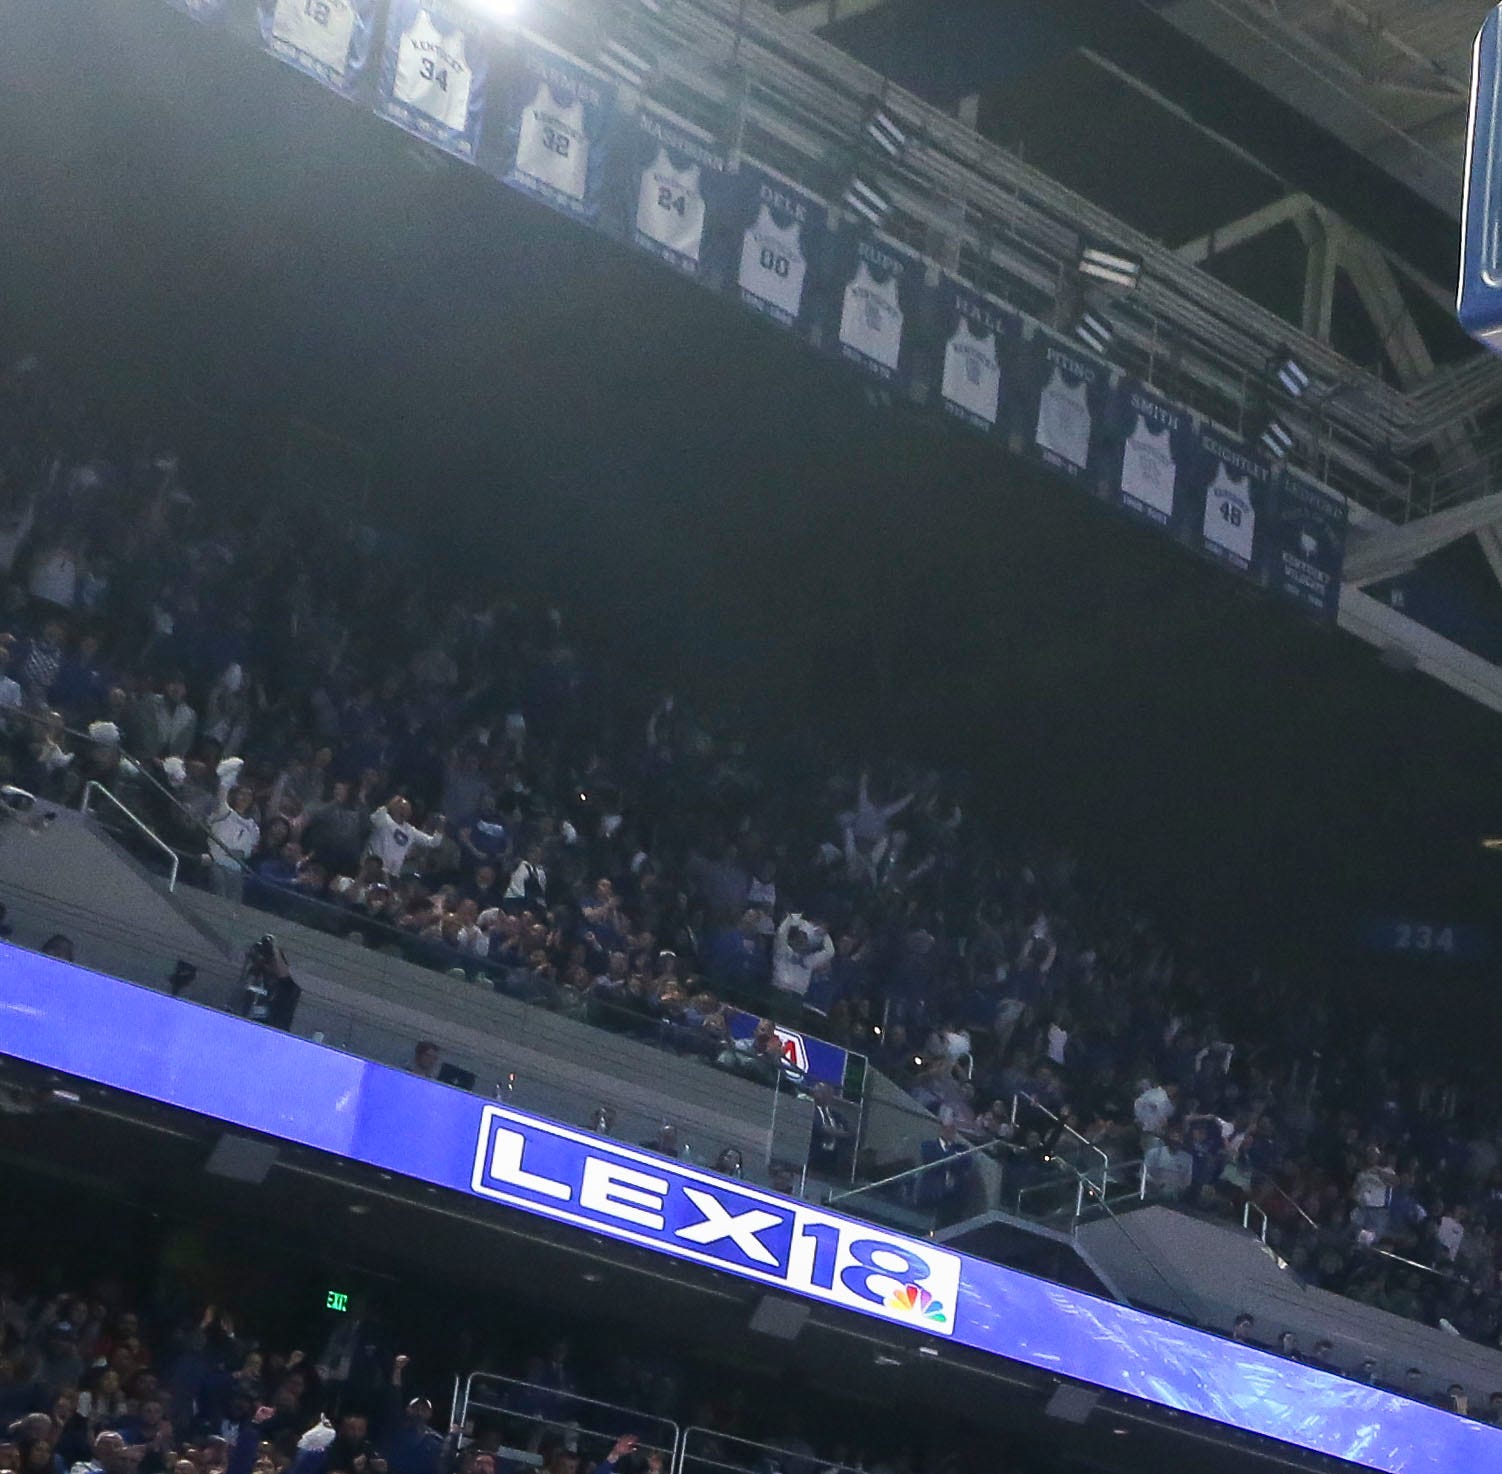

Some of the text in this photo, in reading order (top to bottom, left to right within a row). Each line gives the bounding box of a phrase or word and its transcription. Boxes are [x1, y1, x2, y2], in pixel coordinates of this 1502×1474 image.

[419, 57, 448, 92] 34
[657, 185, 685, 216] 24
[759, 247, 790, 278] 00
[1394, 924, 1455, 952] 234
[326, 1290, 348, 1312] EXIT
